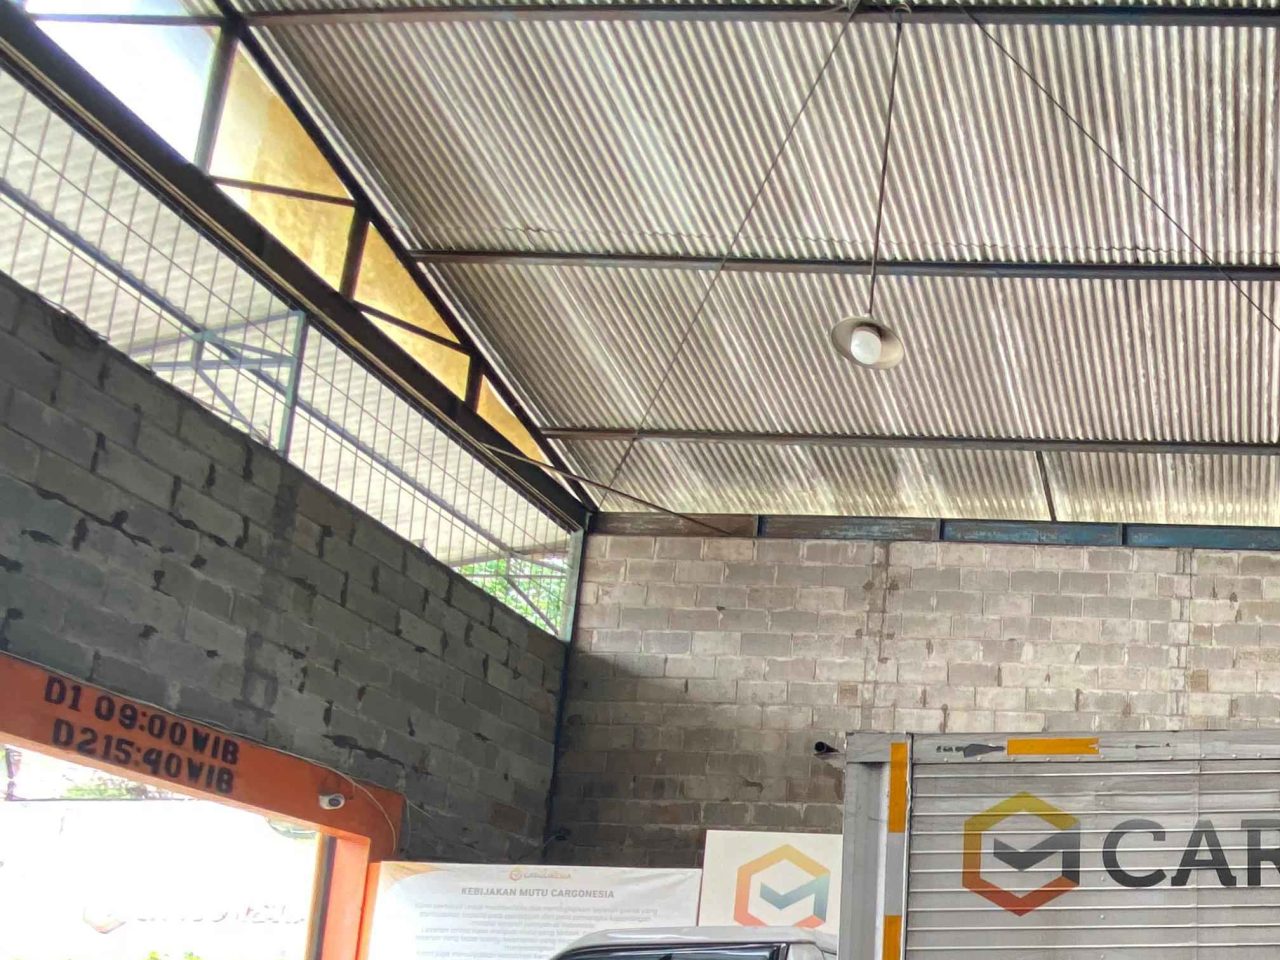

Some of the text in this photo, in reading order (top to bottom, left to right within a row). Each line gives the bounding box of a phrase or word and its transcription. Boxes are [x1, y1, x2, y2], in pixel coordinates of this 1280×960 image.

[44, 675, 83, 712] D1
[461, 887, 615, 899] KEBIJAKAN MUTU CARGONESIA
